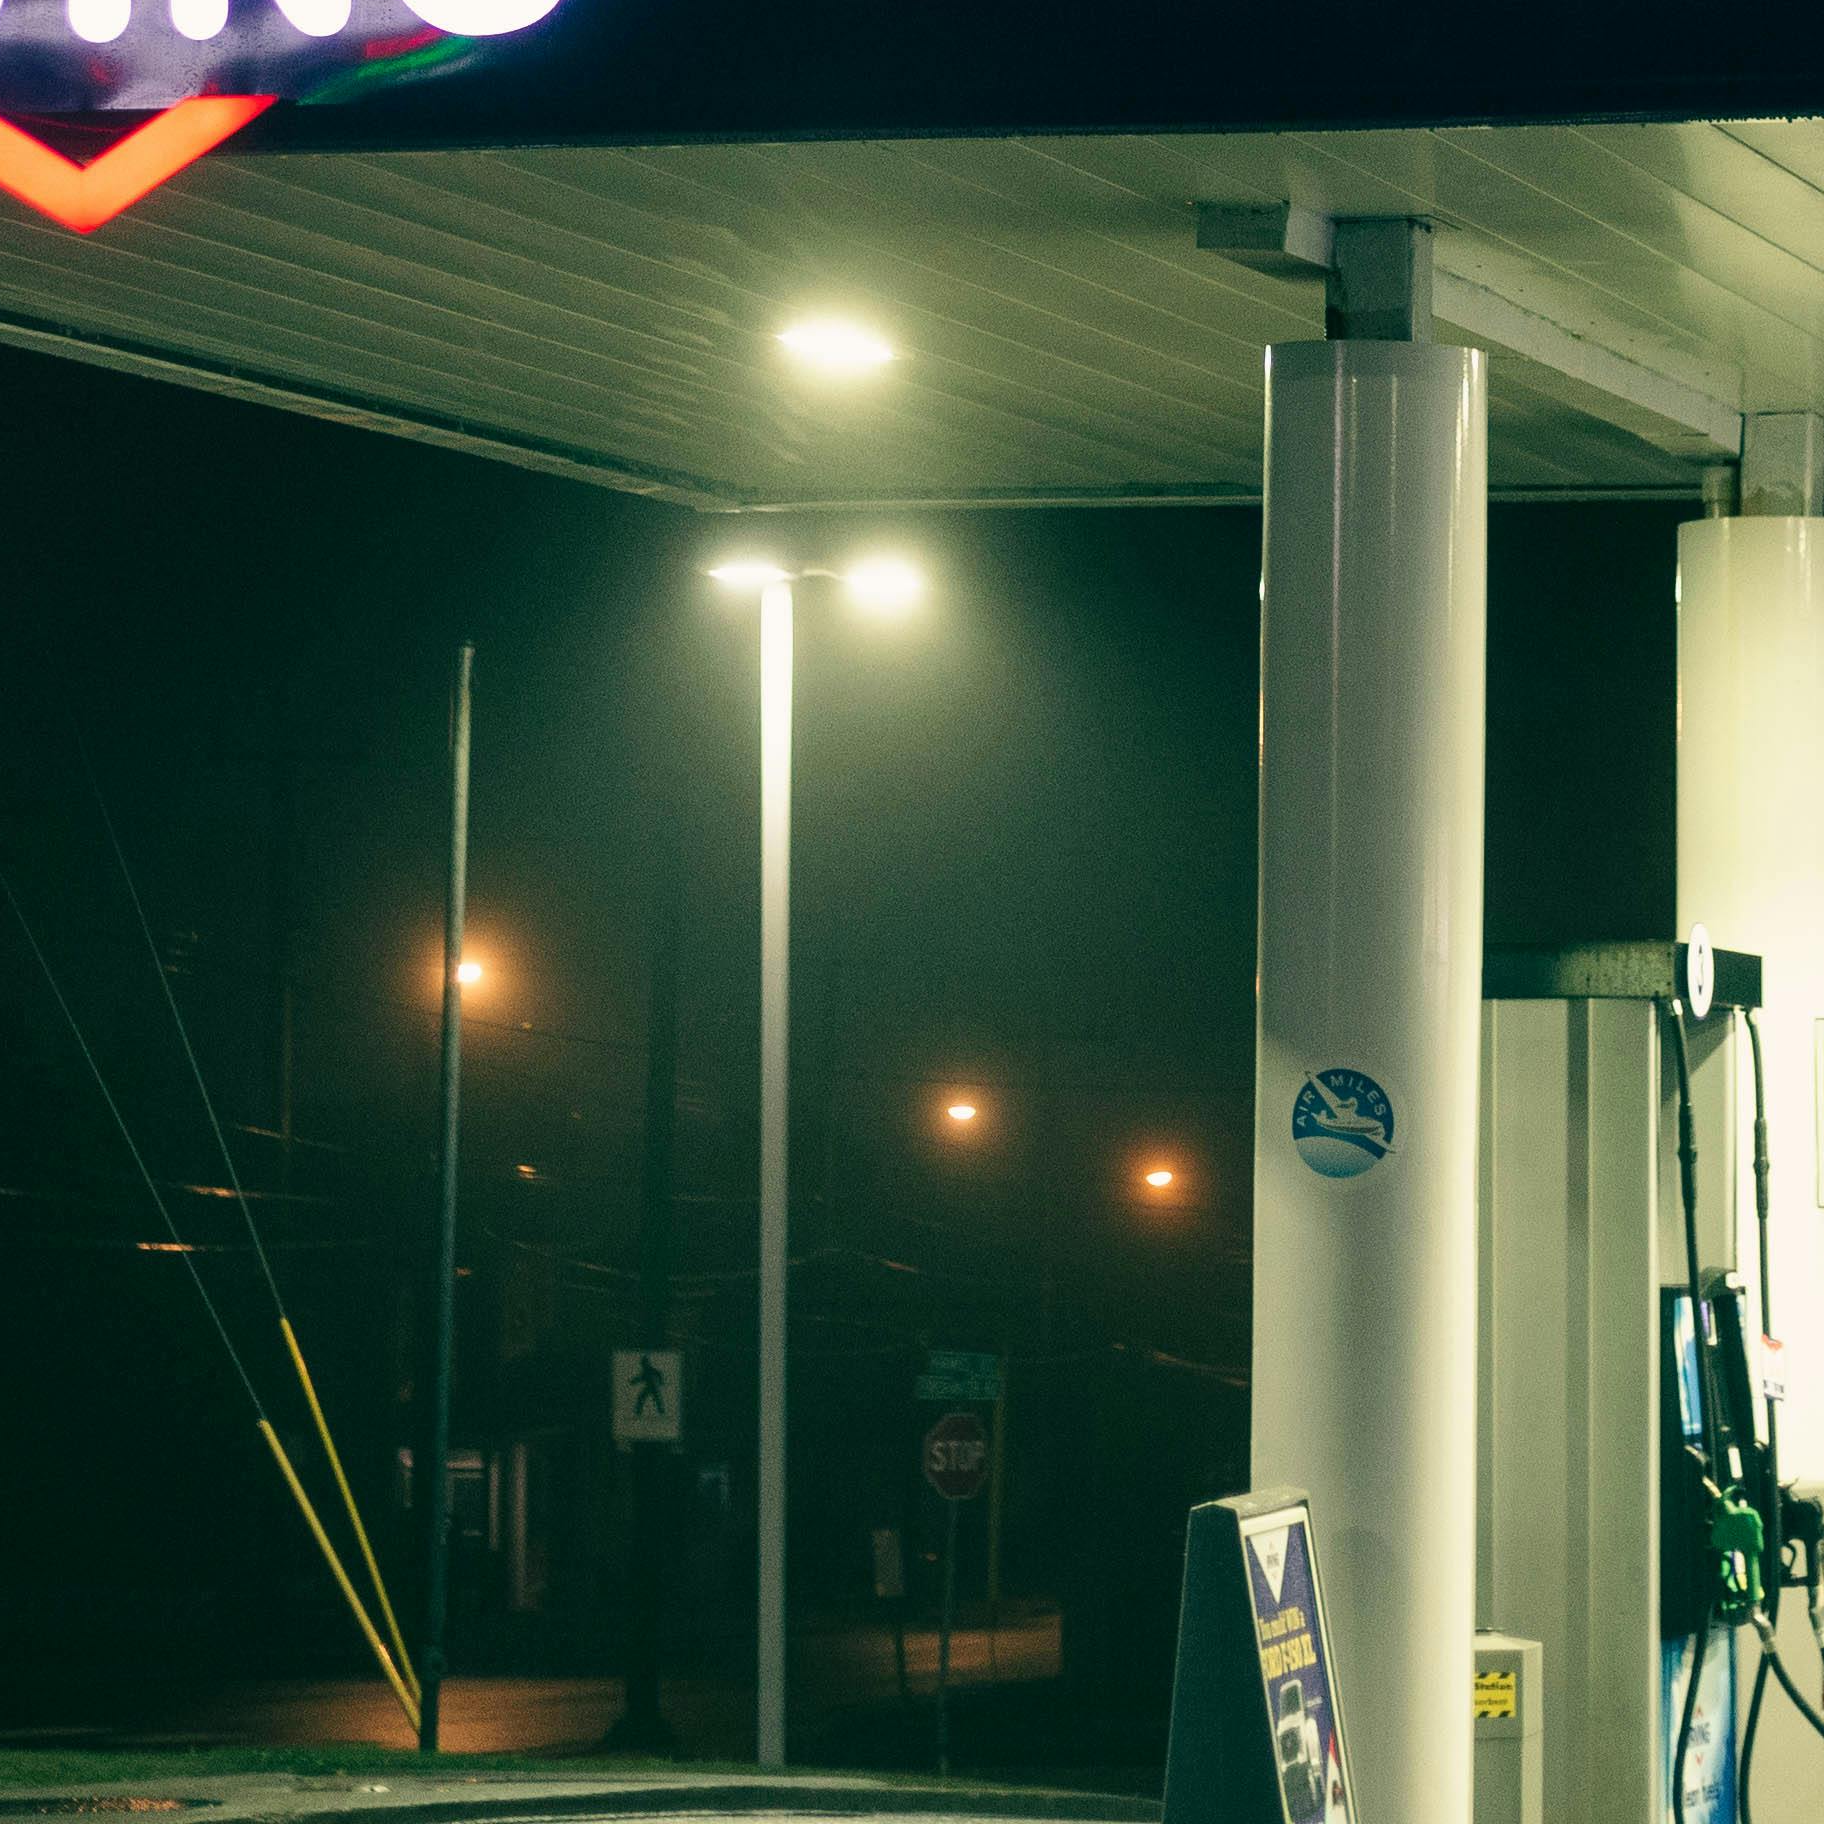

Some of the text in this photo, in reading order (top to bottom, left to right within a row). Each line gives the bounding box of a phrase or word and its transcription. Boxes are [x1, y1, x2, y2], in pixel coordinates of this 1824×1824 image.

[1296, 1074, 1387, 1128] AIR MILES
[930, 1440, 986, 1473] STOP
